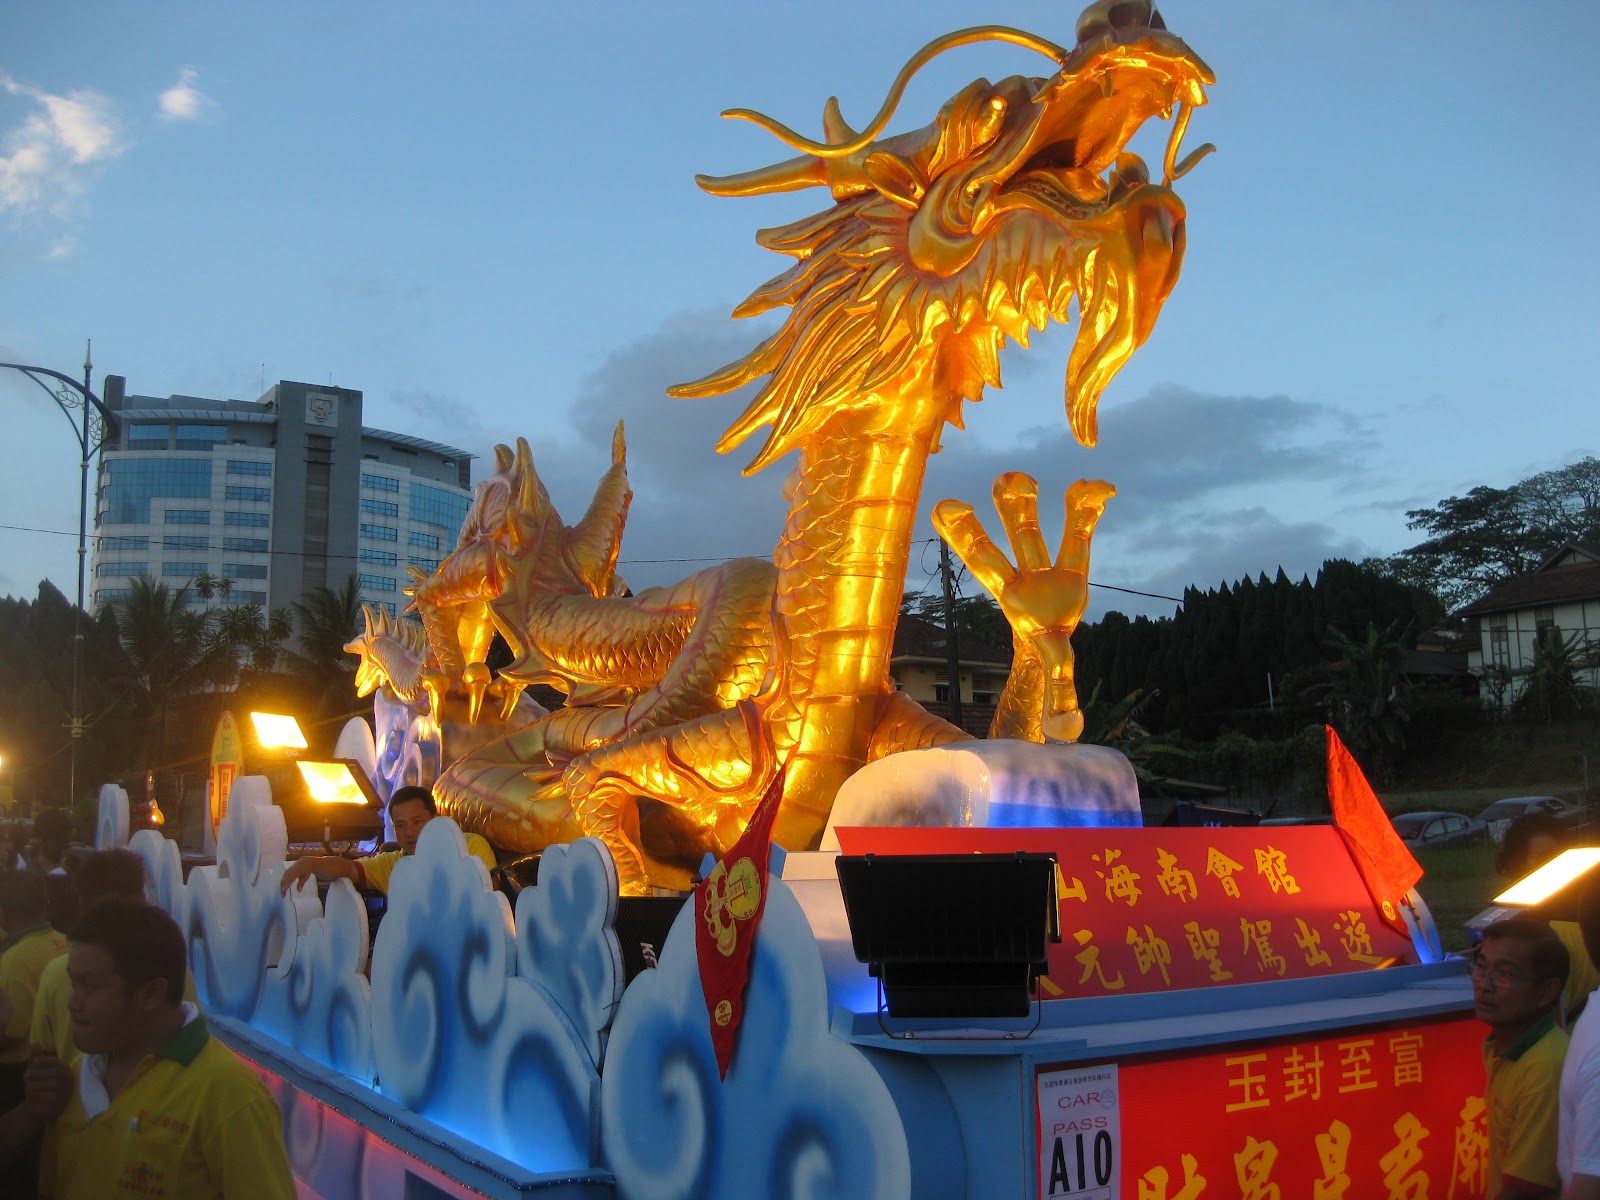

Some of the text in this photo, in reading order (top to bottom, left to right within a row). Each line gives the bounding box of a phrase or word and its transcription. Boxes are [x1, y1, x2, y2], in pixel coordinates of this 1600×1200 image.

[1040, 911, 1383, 995] 元帥聖駕出遊
[1225, 1031, 1424, 1113] 玉封至富
[1053, 1116, 1108, 1136] PASS
[1057, 1092, 1101, 1109] CAR
